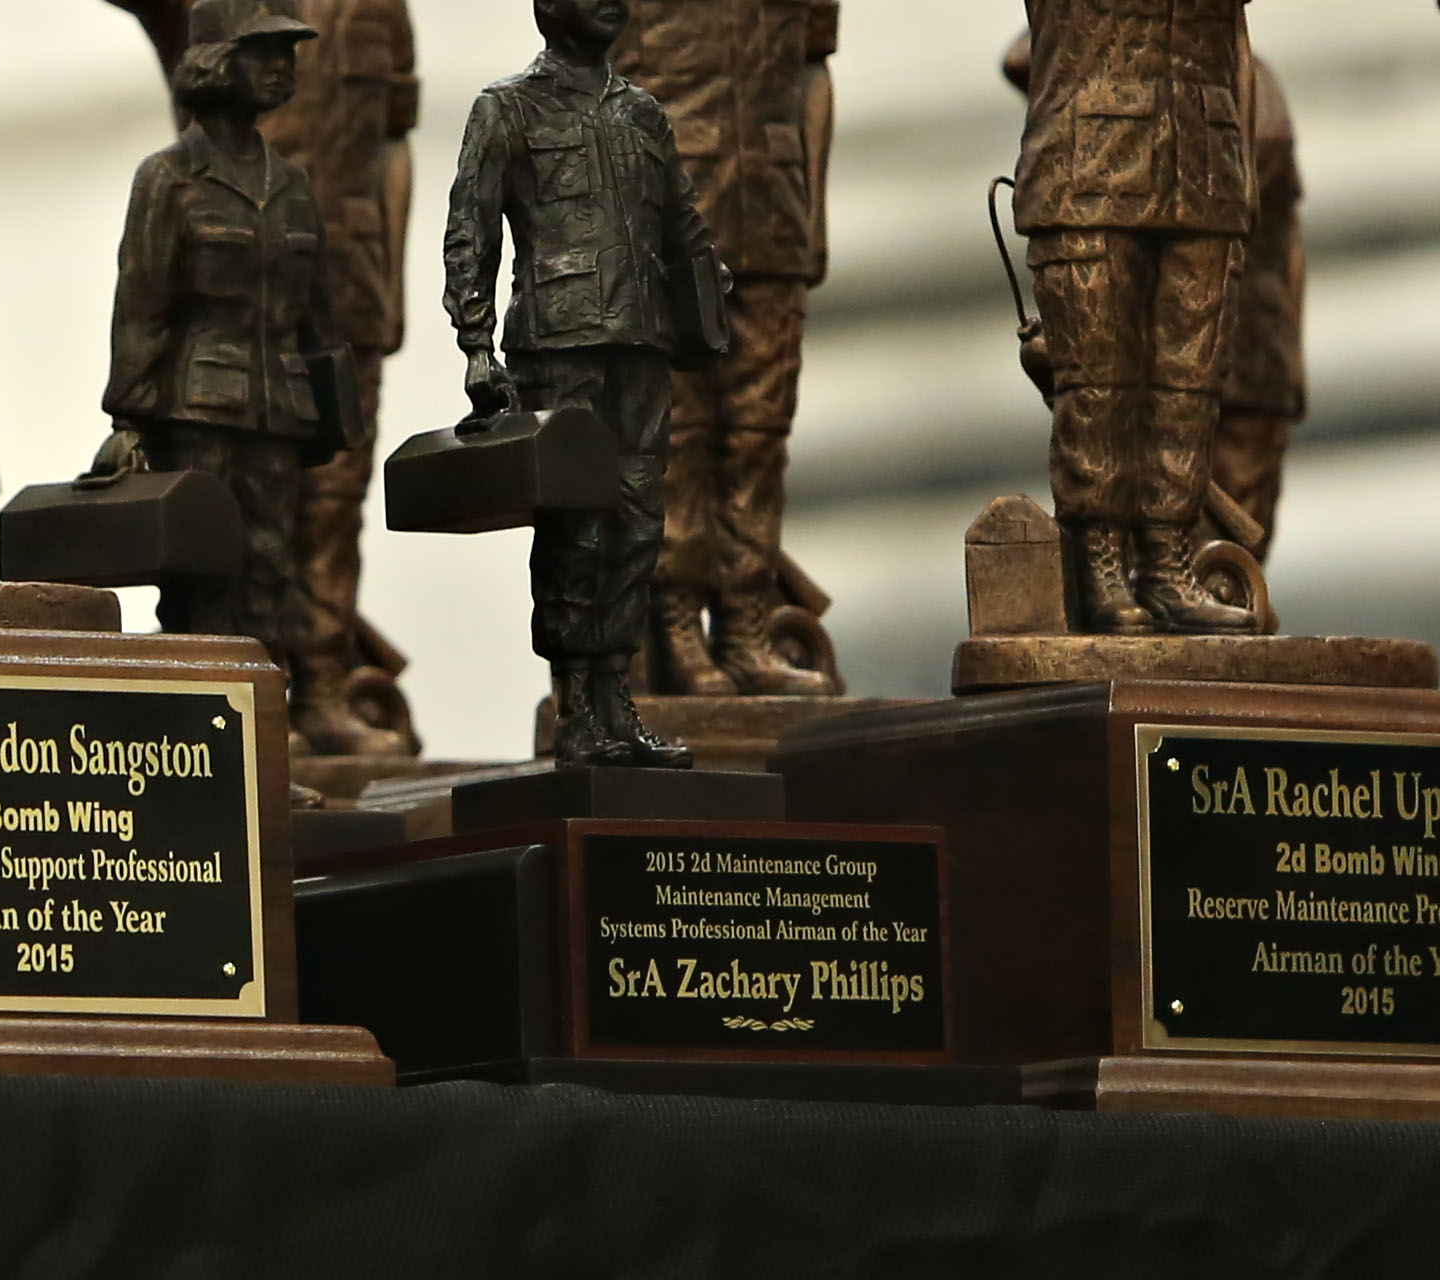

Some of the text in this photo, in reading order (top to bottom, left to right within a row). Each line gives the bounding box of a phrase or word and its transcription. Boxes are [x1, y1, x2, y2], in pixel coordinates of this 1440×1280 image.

[70, 724, 212, 796] Sangston
[1192, 765, 1256, 815] SrA
[1264, 768, 1383, 818] Rachel
[67, 801, 133, 841] Wing
[1, 847, 86, 890] Support
[92, 849, 222, 882] Professional
[647, 852, 876, 882] 2015 2d Maintenance Group
[1276, 842, 1306, 872] 2d
[1315, 844, 1384, 875] Bomb
[28, 898, 54, 931] of
[62, 900, 103, 932] the
[110, 901, 166, 933] Year
[656, 885, 870, 915] Maintenance Management
[1187, 888, 1269, 920] Reserve
[1276, 890, 1409, 923] Maintenance
[601, 917, 927, 944] Systems Professional Airman of the Year
[17, 943, 73, 972] 2015
[1252, 942, 1344, 974] Airman
[1352, 944, 1377, 974] of
[1384, 945, 1422, 976] the
[609, 958, 924, 1014] SrA Zachary Phillips
[1342, 987, 1394, 1015] 2015
